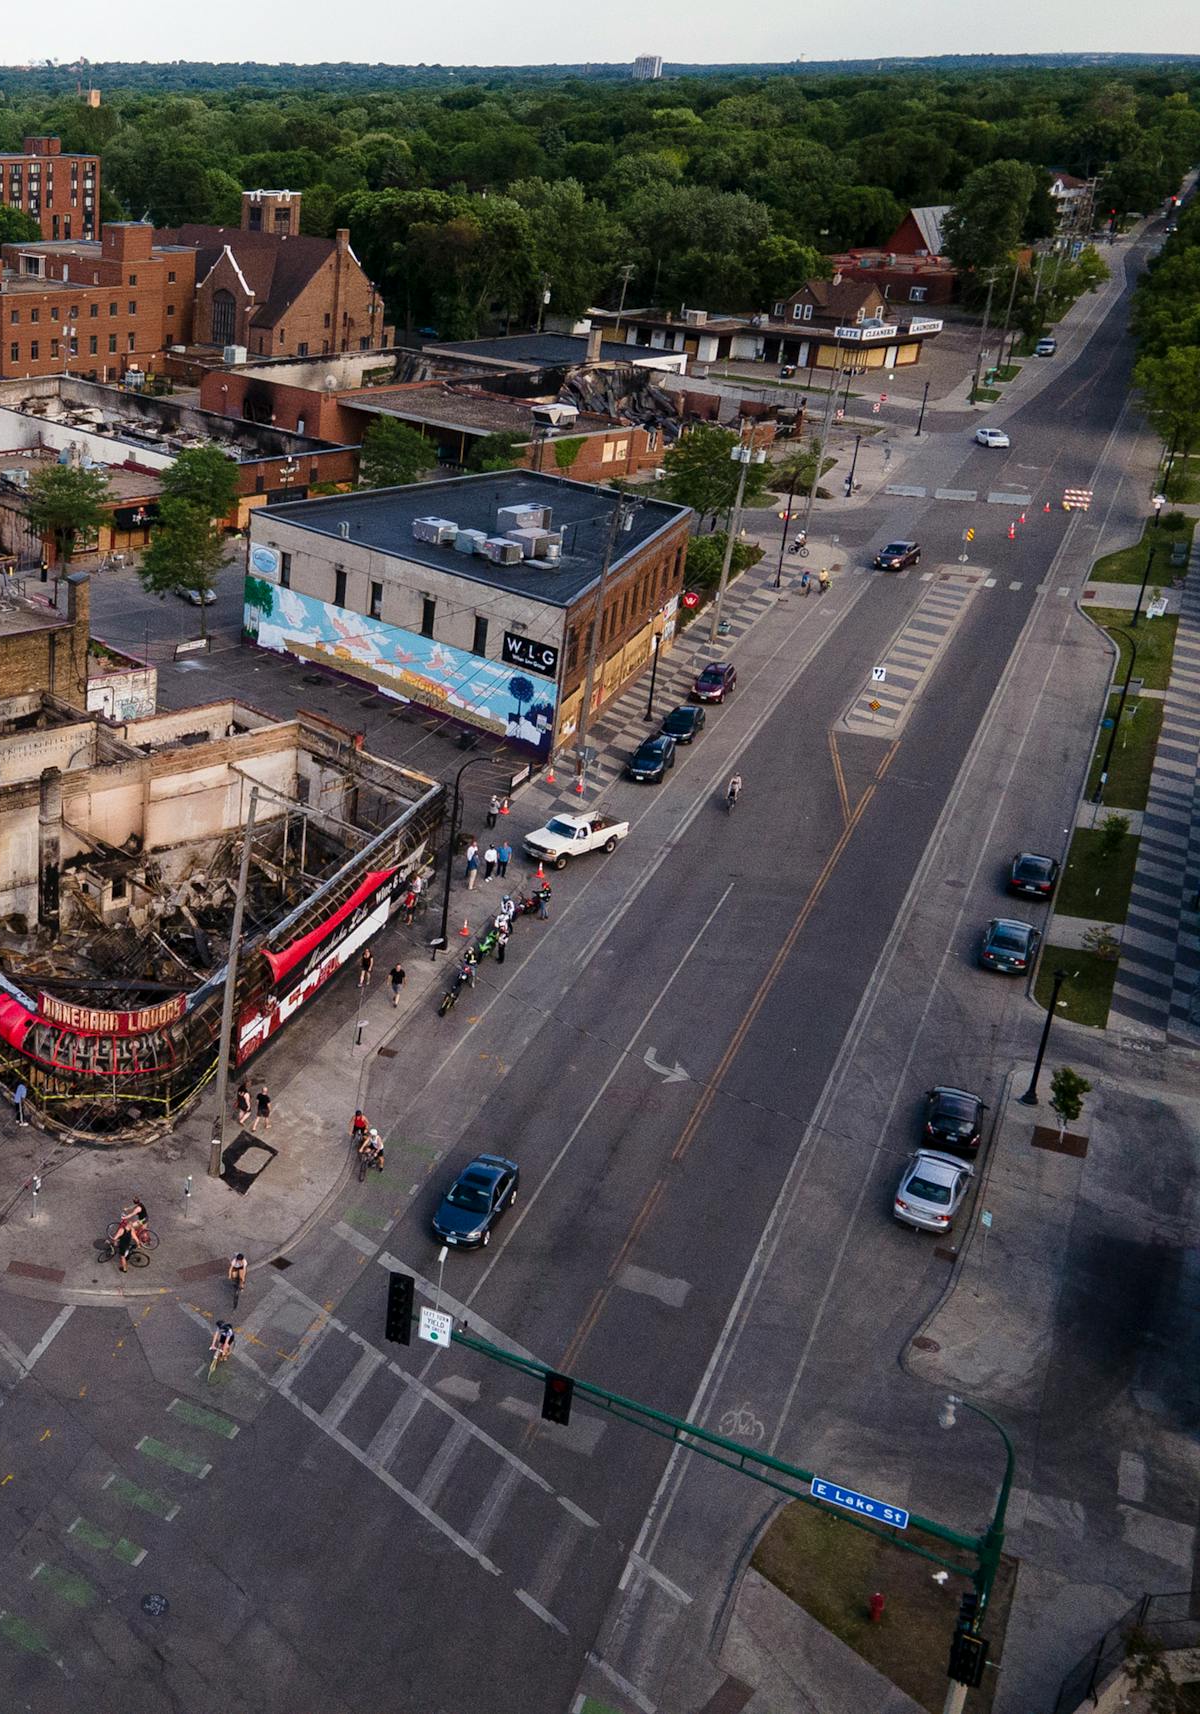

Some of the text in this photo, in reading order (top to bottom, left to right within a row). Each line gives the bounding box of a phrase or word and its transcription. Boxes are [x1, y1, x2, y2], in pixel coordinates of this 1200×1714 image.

[865, 327, 894, 338] CLEANERS
[912, 322, 940, 332] LAUNDERS
[43, 996, 181, 1032] MINNEHAHA LIQUORS
[423, 1310, 449, 1322] LEFT TURN
[427, 1318, 445, 1328] YIELD
[432, 1326, 446, 1334] GREEN
[816, 1484, 902, 1523] E Lake St
